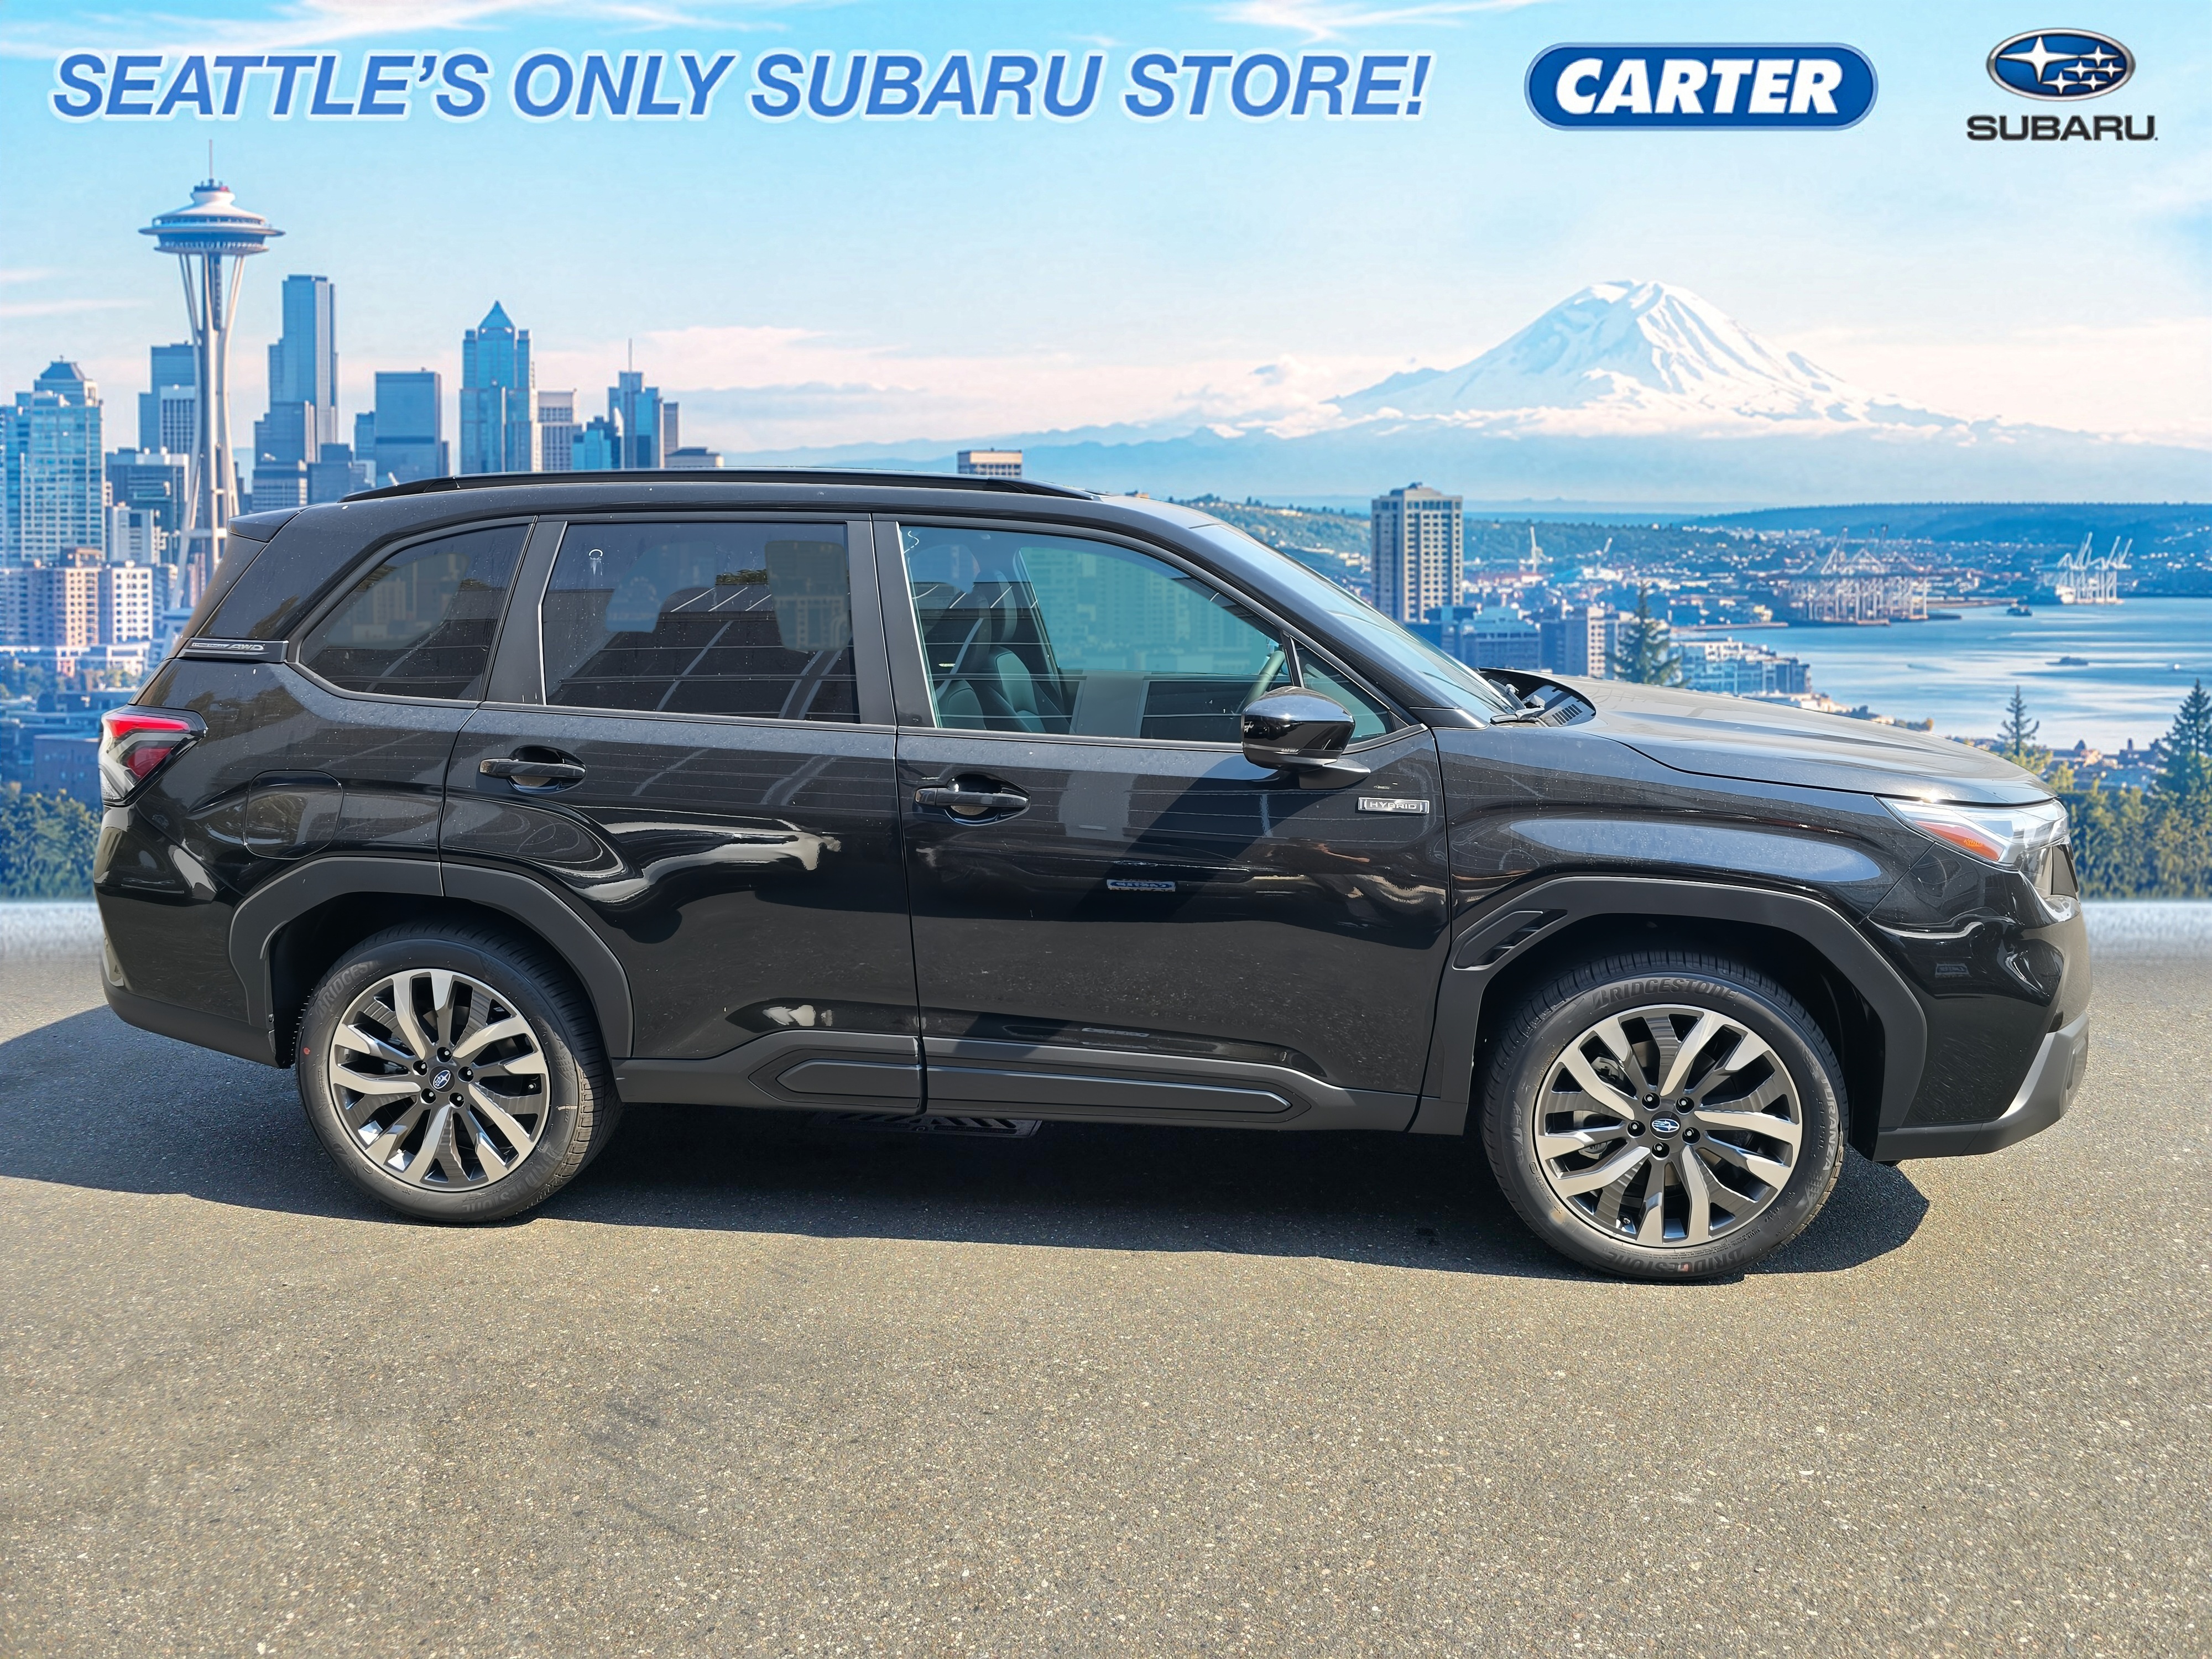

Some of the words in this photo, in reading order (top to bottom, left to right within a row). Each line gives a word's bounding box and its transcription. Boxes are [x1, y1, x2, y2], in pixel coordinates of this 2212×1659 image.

[1370, 801, 1417, 810] HYBRID
[1591, 978, 1739, 1010] BRIDGESTONE
[1822, 1078, 1839, 1170] TURANZA
[1603, 1248, 1746, 1273] BRIDGESTONE
